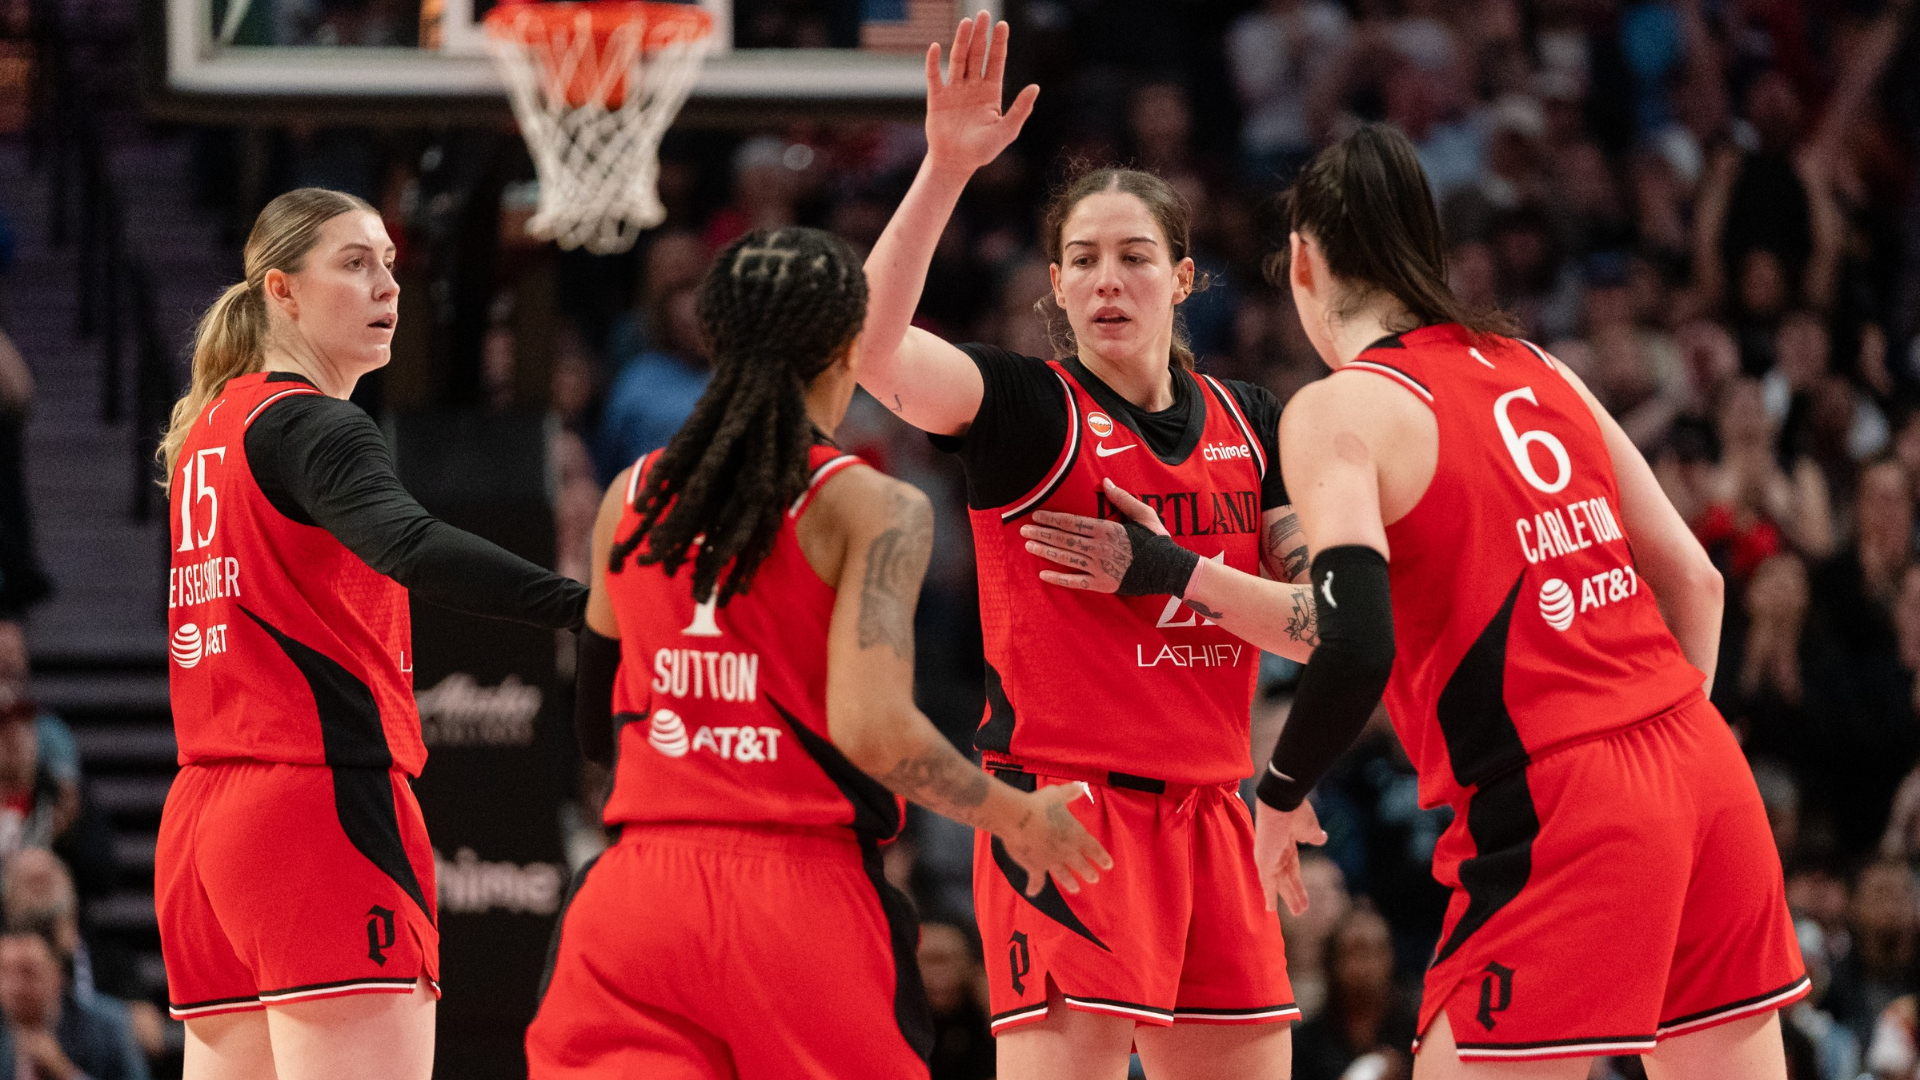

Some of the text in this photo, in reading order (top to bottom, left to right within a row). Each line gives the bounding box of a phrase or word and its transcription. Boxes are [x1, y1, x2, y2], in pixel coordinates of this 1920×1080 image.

[1203, 442, 1251, 461] chime
[1493, 386, 1572, 494] 6
[176, 446, 226, 552] 15
[1095, 491, 1257, 536] RTLAND
[1515, 496, 1623, 564] CARLETON
[652, 648, 759, 702] SUTTON
[1137, 644, 1242, 667] LASHIFY
[692, 725, 782, 762] AT&T
